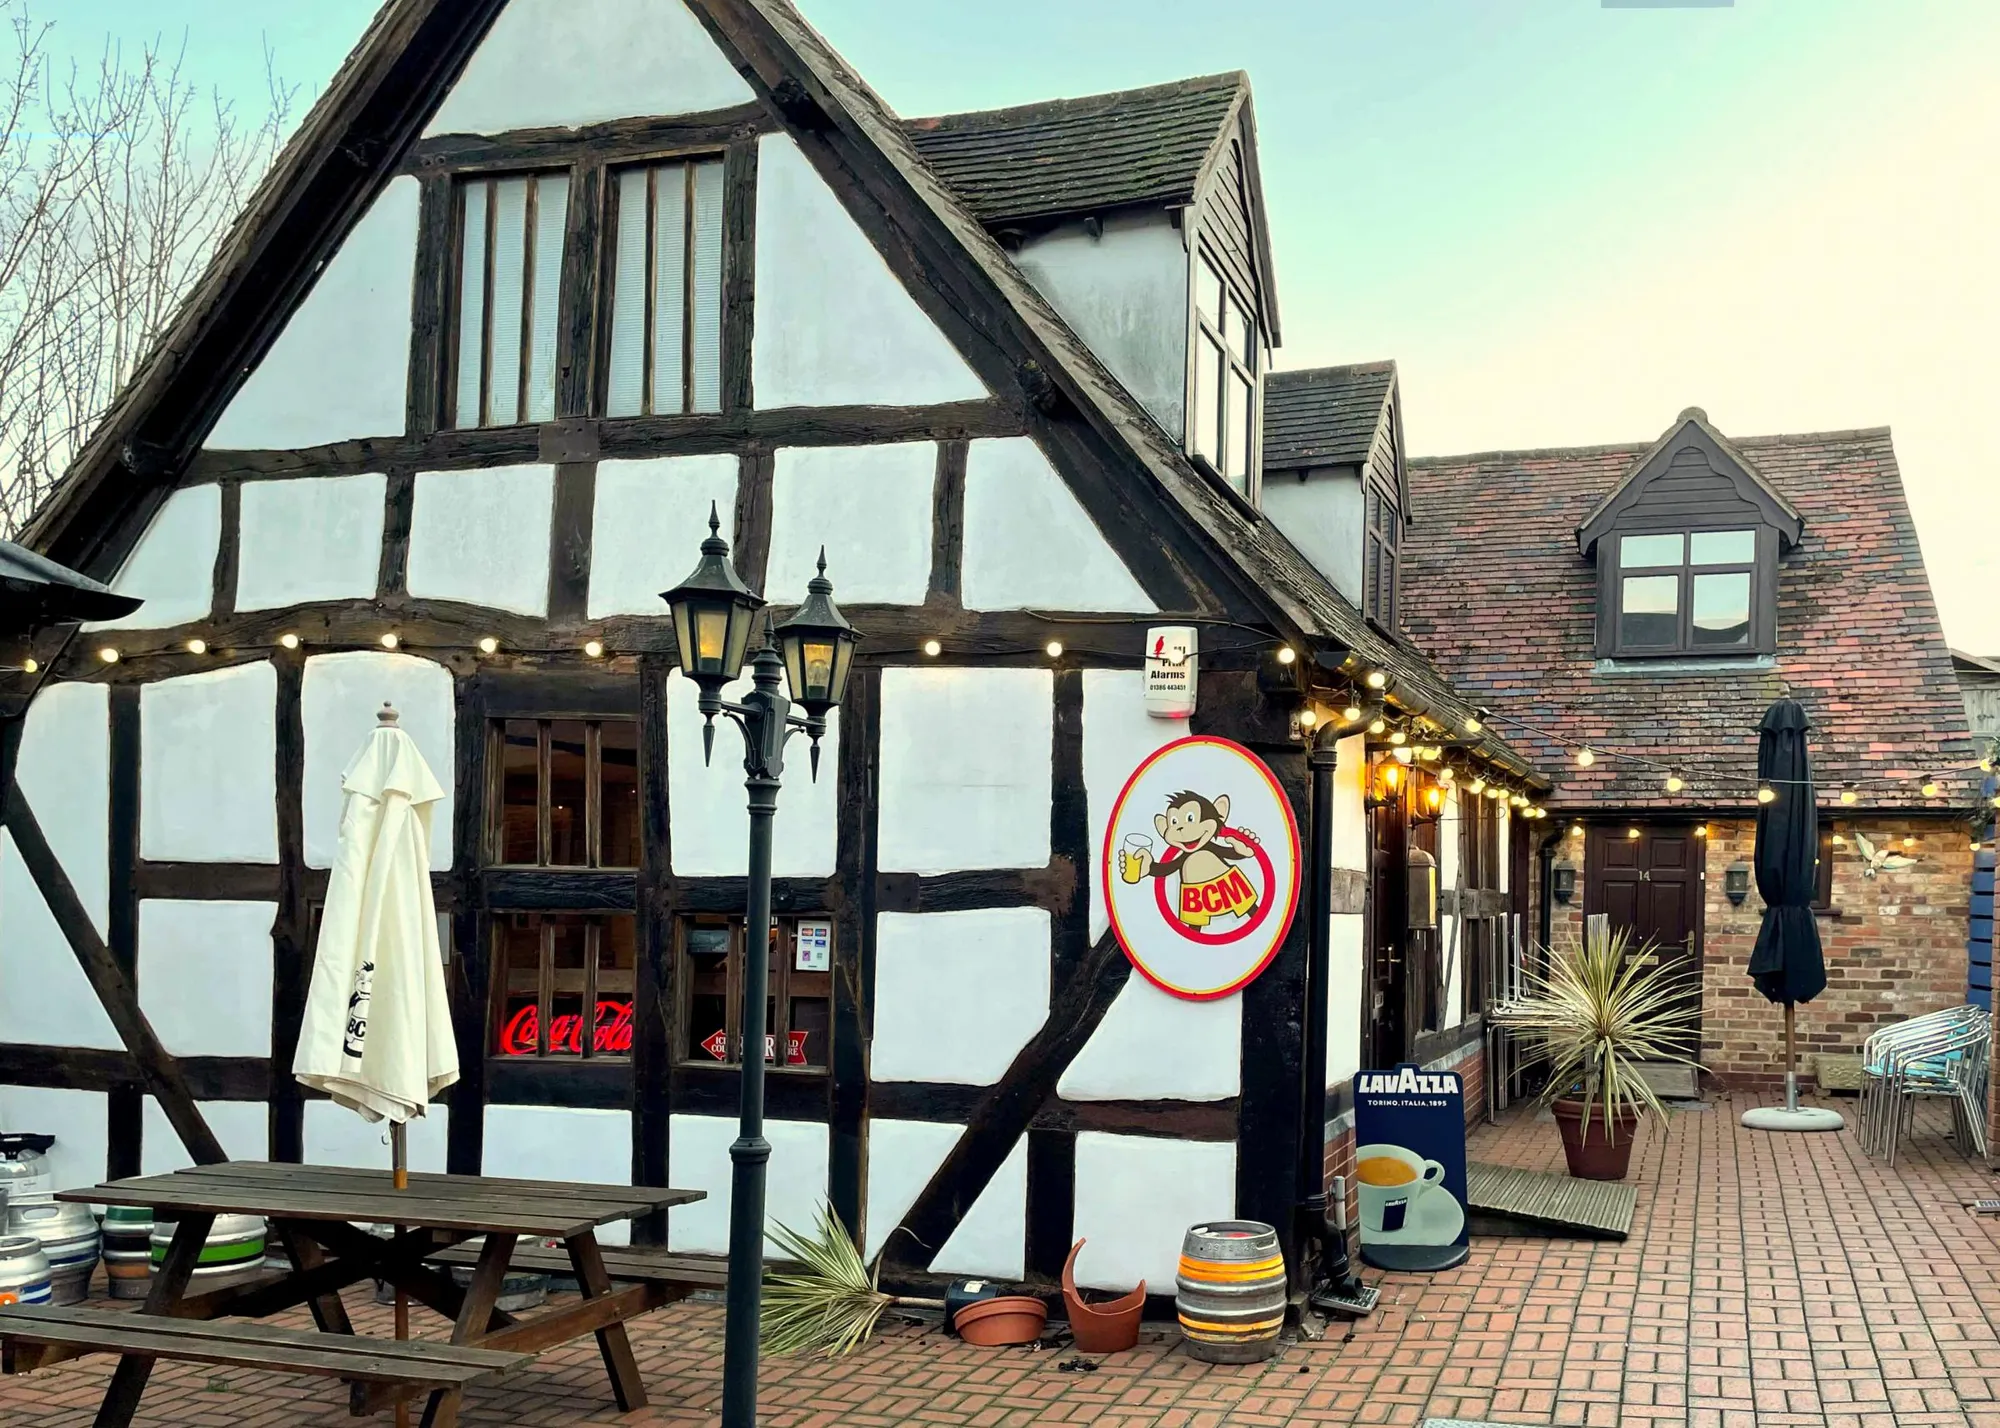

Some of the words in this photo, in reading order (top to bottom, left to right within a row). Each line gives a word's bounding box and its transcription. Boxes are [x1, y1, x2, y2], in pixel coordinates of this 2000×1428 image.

[1151, 670, 1185, 679] Alarms
[1639, 870, 1651, 881] 14
[1183, 870, 1253, 913] BCM
[347, 1017, 367, 1038] BC
[502, 1001, 633, 1056] Coa-Cola
[711, 1044, 726, 1053] COL
[1358, 1068, 1459, 1094] LAVAZZA
